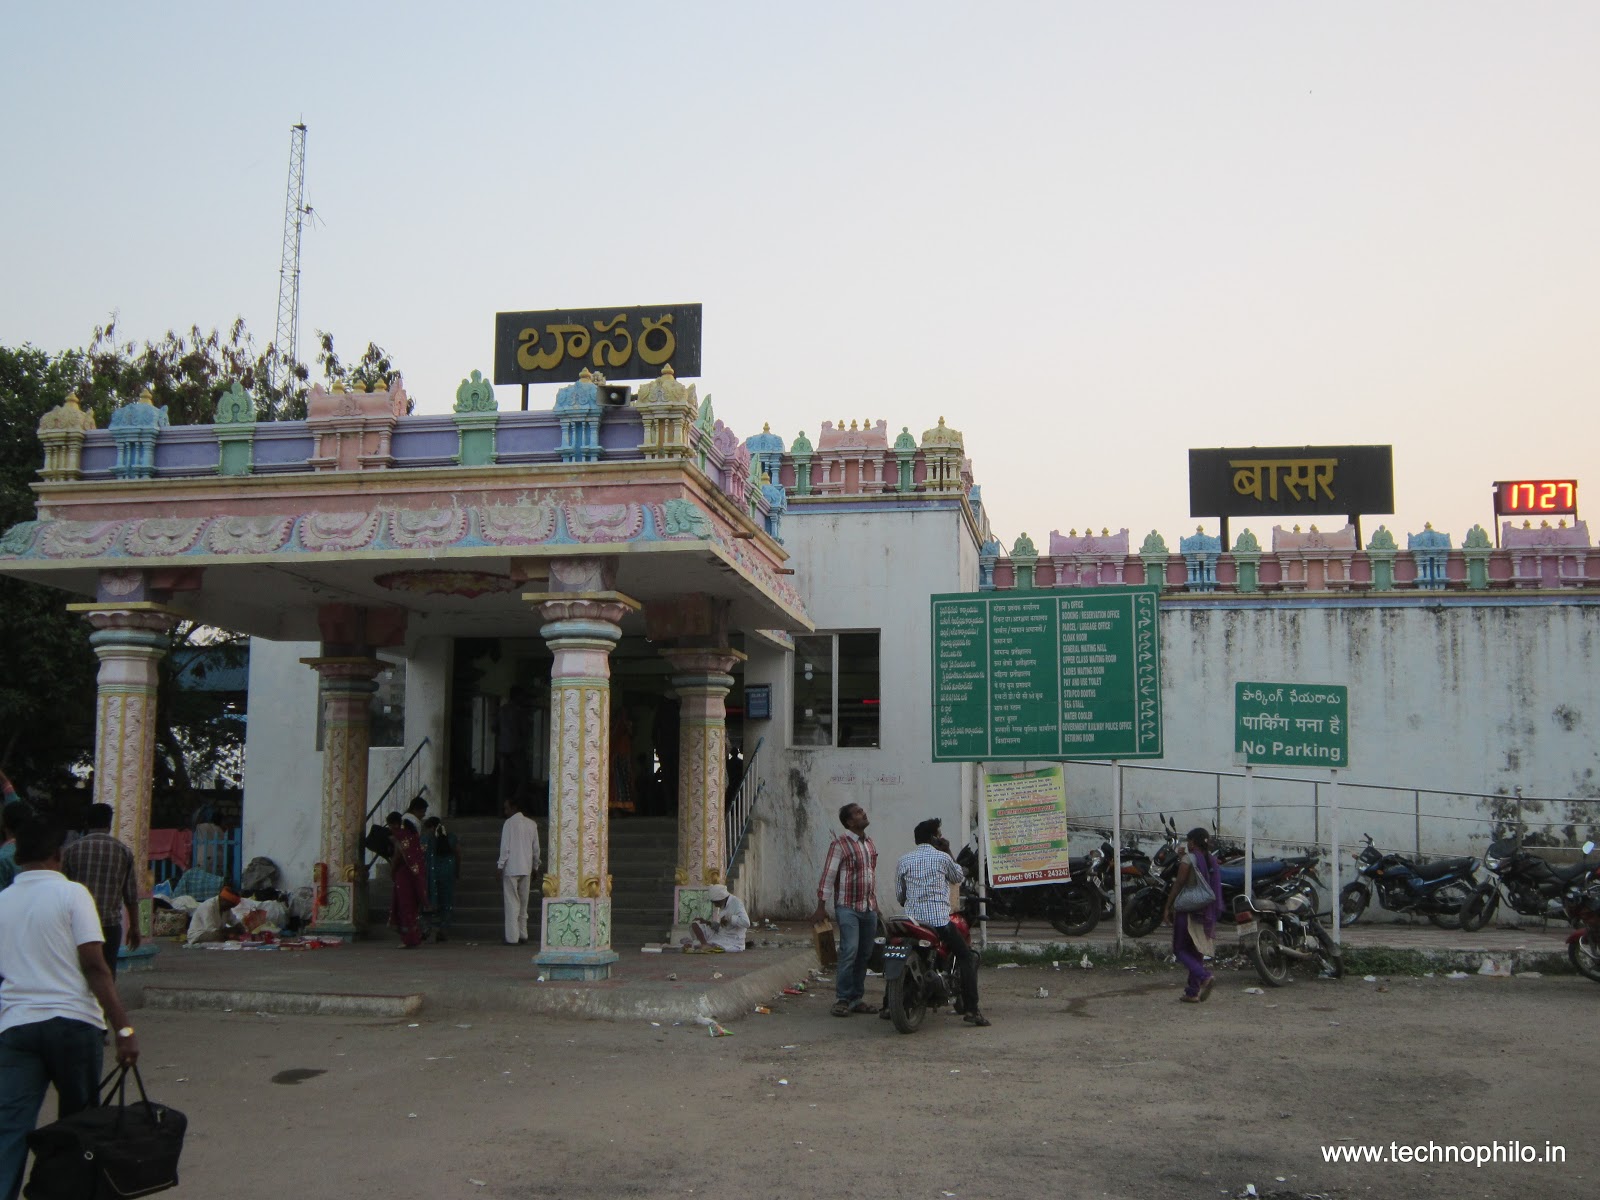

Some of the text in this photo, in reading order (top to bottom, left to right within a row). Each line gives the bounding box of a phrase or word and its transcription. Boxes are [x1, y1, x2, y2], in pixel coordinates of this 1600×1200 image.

[517, 313, 676, 371] బాసర
[1229, 458, 1339, 502] बासर
[1071, 600, 1084, 609] OFFICE
[1062, 612, 1079, 620] BOOKING
[1082, 610, 1107, 620] RESERVATION
[1107, 610, 1120, 618] OFFICE
[1062, 623, 1077, 631] PARCEL
[1080, 622, 1097, 630] LUGGAGE
[1098, 622, 1111, 630] OFFICE
[1063, 633, 1087, 642] CLOAK ROOM
[1063, 644, 1107, 653] GENERAL WAITING HALL
[1063, 654, 1117, 664] UPPER CLASS WAITING ROOM
[1063, 666, 1105, 676] LADIES WAITING ROOM
[1072, 678, 1080, 686] AND
[1088, 677, 1102, 686] TOILET
[1064, 700, 1084, 708] TEA STALL
[1064, 712, 1093, 720] WATER COOLER
[1062, 722, 1132, 731] GOVERNMENT RAILWAY POLICE OFFICE
[1296, 718, 1324, 733] मना
[1329, 714, 1340, 734] है
[1064, 734, 1094, 742] RETIRING ROOM
[1242, 741, 1340, 762] No Parking
[998, 874, 1023, 882] Contact:
